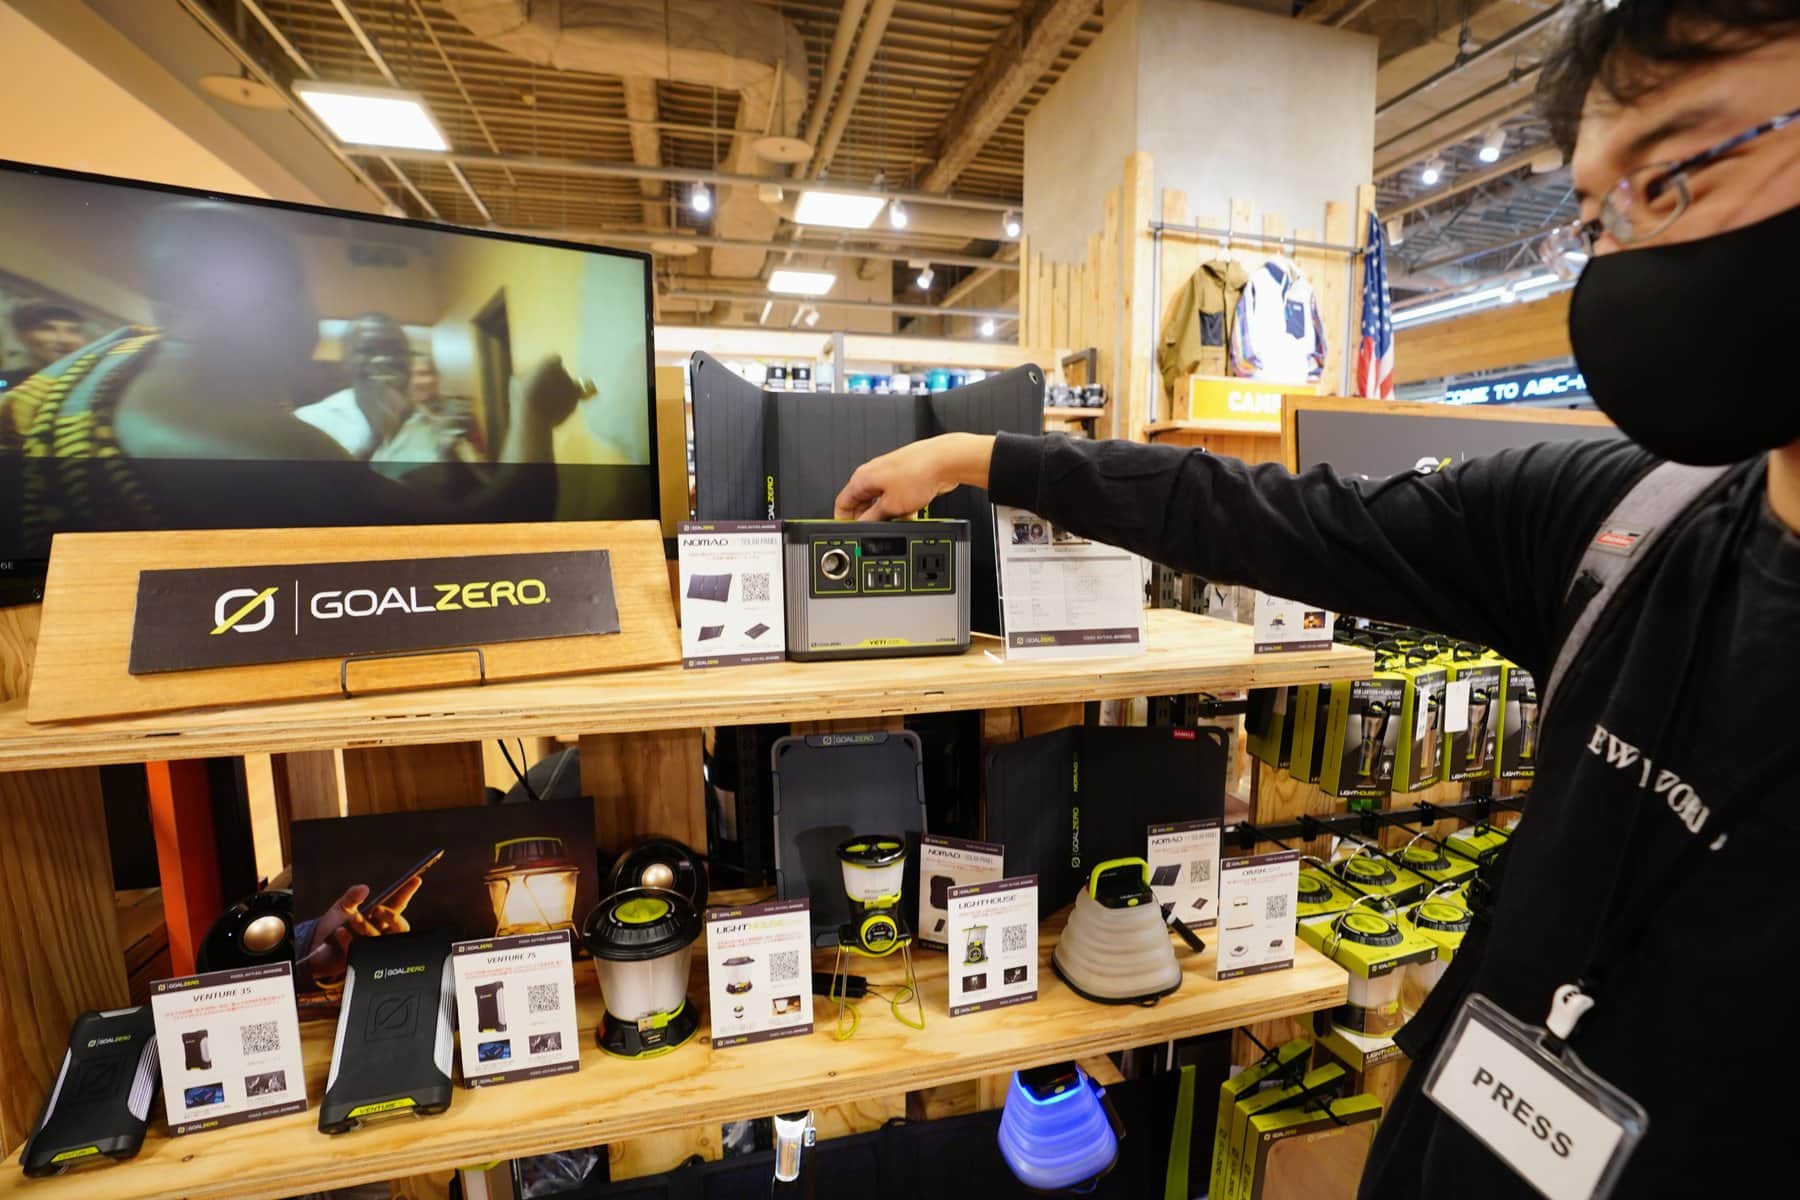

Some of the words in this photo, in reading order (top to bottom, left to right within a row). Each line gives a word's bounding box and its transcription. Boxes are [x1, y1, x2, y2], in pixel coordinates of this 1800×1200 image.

[1493, 381, 1519, 400] TO
[958, 894, 1016, 910] LIGHTHOUSE
[487, 953, 525, 965] VENTURE
[387, 965, 425, 977] GOALZERO
[193, 990, 236, 1002] VENTURE
[1472, 1067, 1573, 1158] PRESS
